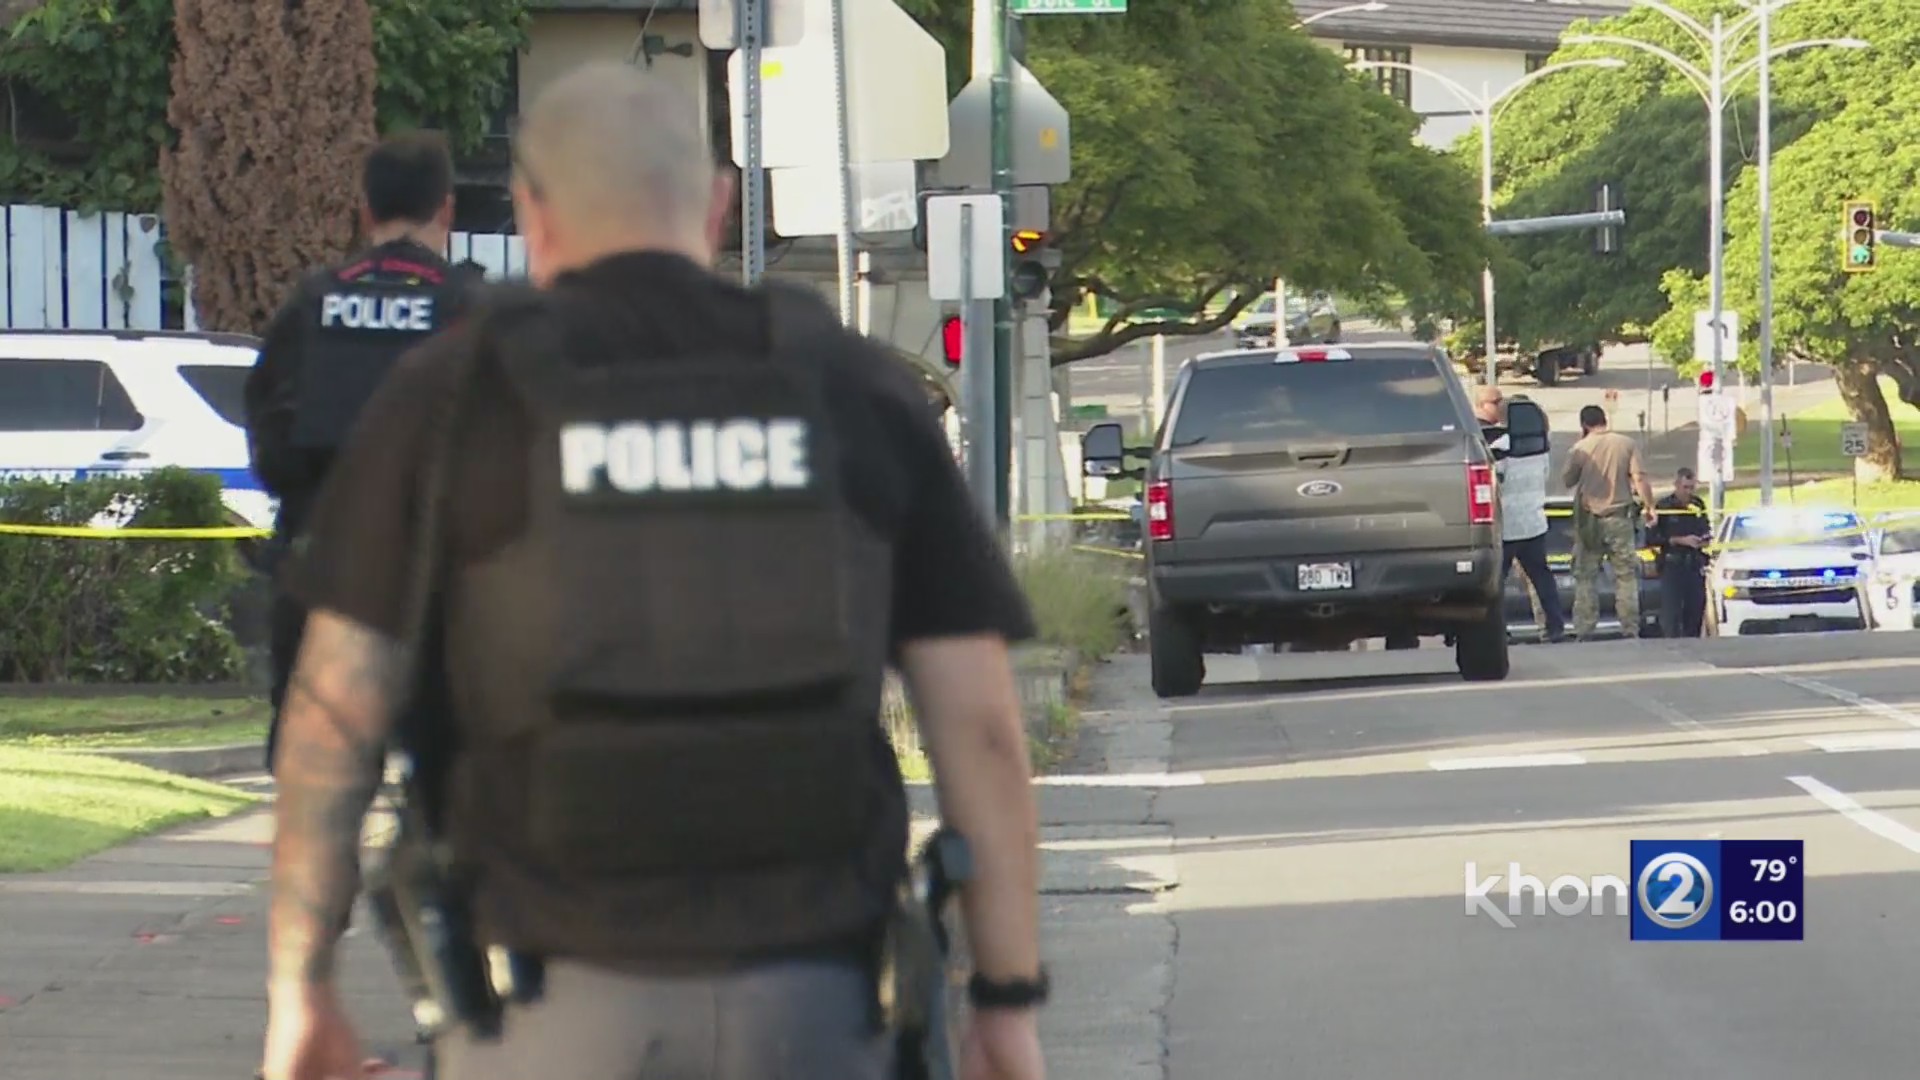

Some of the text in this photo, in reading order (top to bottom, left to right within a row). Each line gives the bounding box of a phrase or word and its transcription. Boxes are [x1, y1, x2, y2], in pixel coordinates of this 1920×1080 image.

[321, 295, 433, 330] POLICE
[559, 419, 809, 493] POLICE
[1844, 439, 1865, 454] 25
